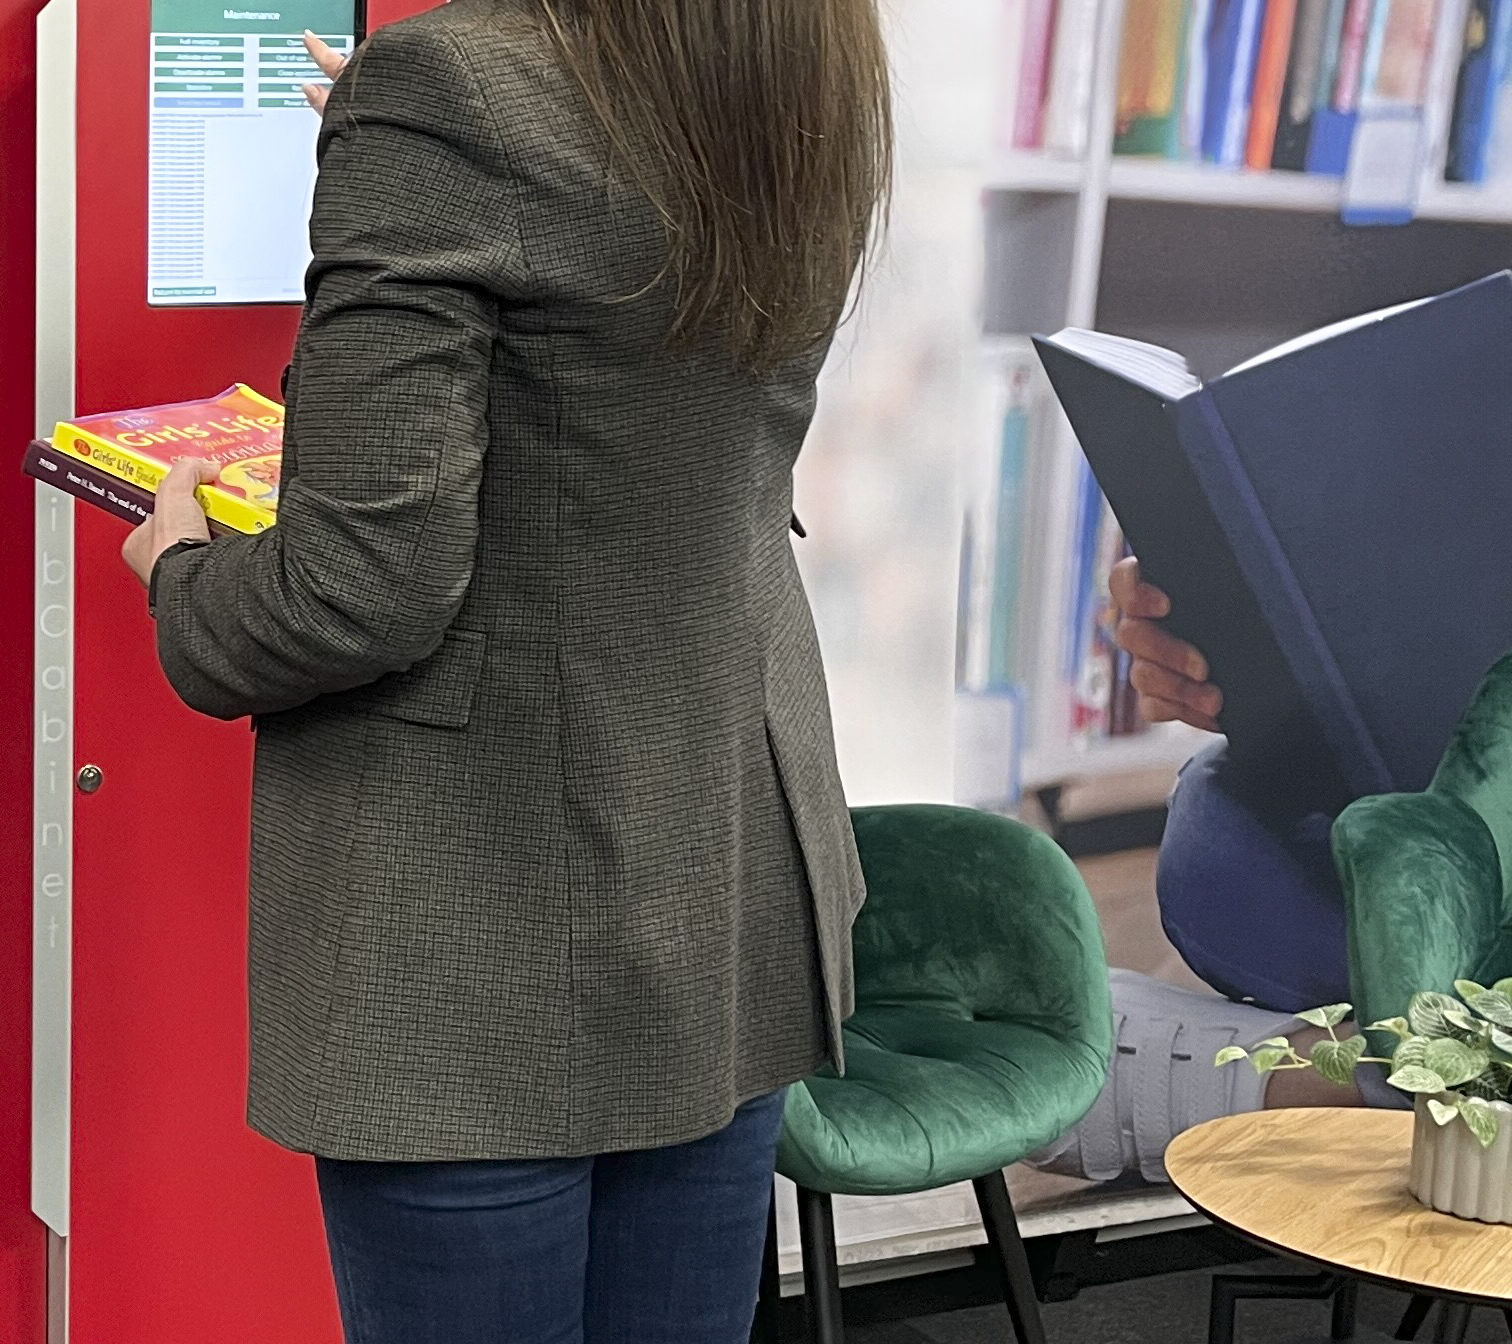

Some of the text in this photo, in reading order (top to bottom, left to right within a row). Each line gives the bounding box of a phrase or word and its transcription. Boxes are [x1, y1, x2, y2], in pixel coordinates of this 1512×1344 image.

[208, 414, 284, 434] Life
[117, 457, 135, 476] Life
[39, 497, 66, 948] ibCabinet
